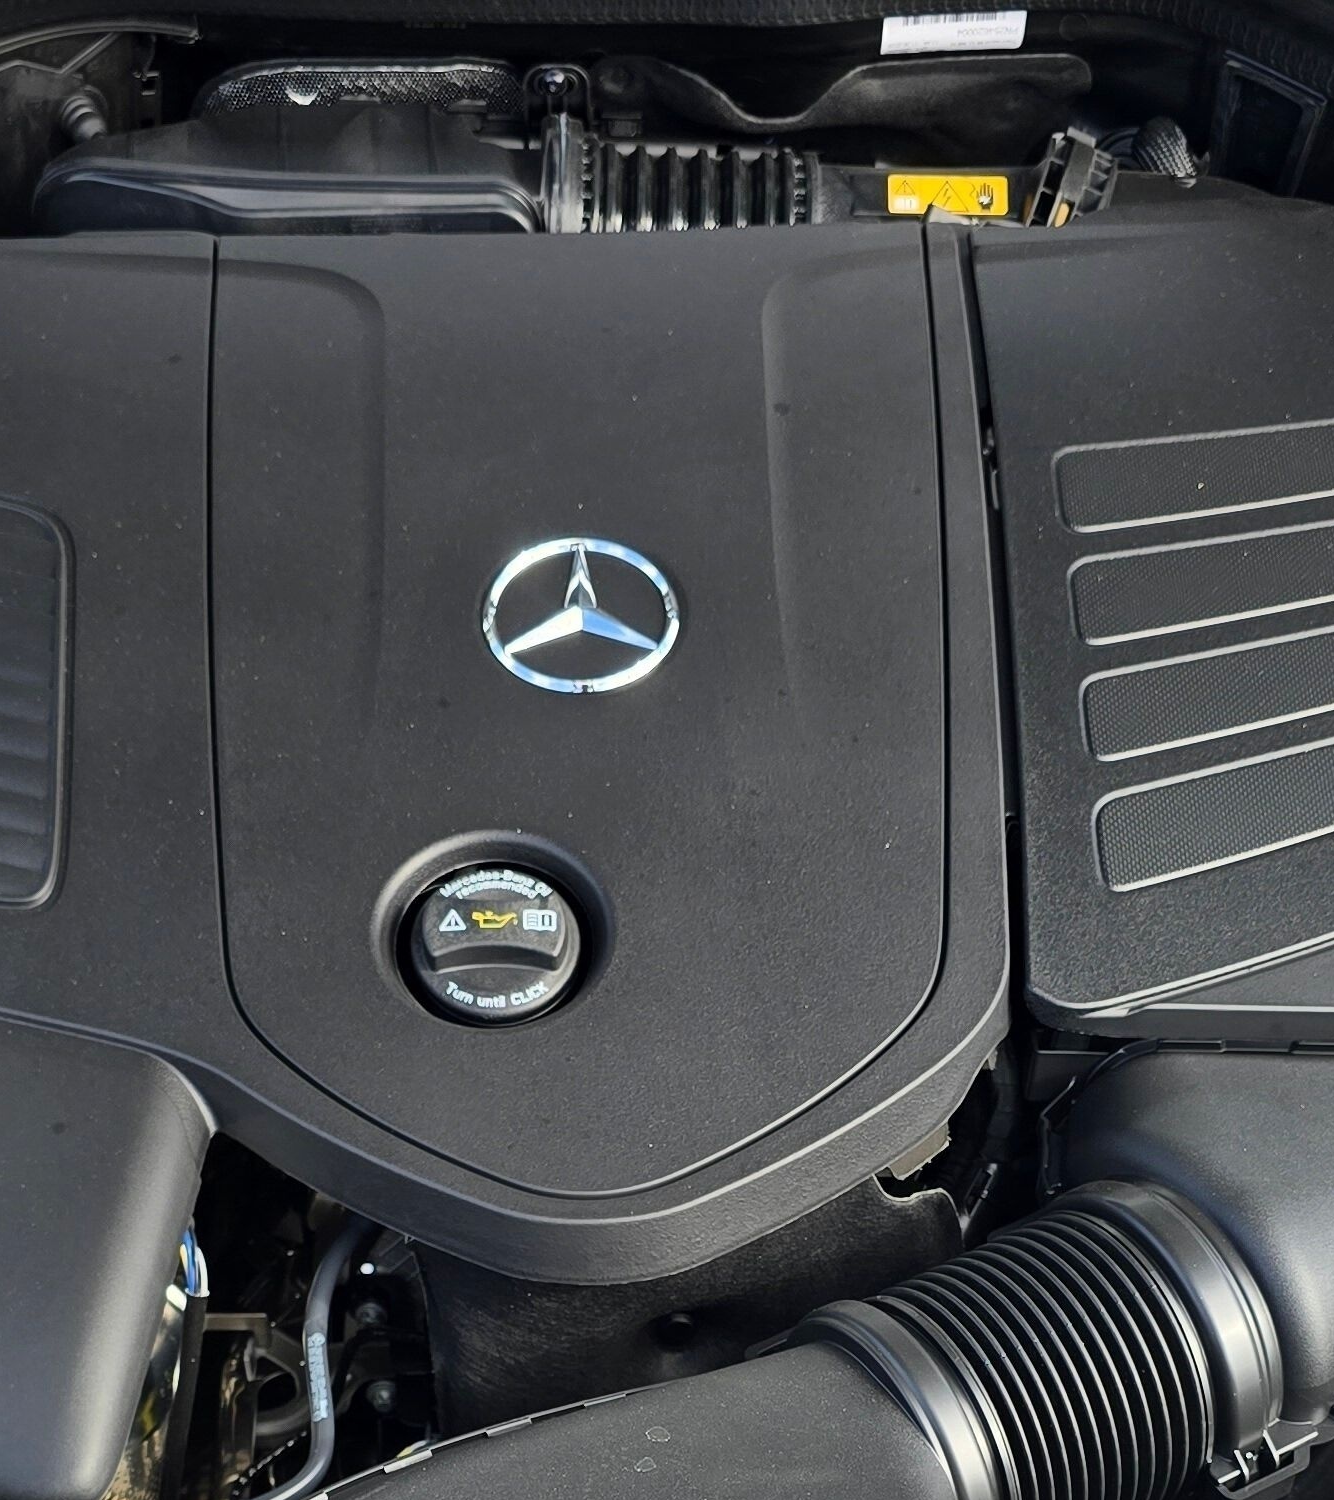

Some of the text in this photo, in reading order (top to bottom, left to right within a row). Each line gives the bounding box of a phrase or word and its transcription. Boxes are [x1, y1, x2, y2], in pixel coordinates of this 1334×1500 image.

[439, 869, 536, 898] Mercedes-Benz
[455, 880, 538, 899] recommended
[446, 981, 549, 1008] Turn until CLICK
